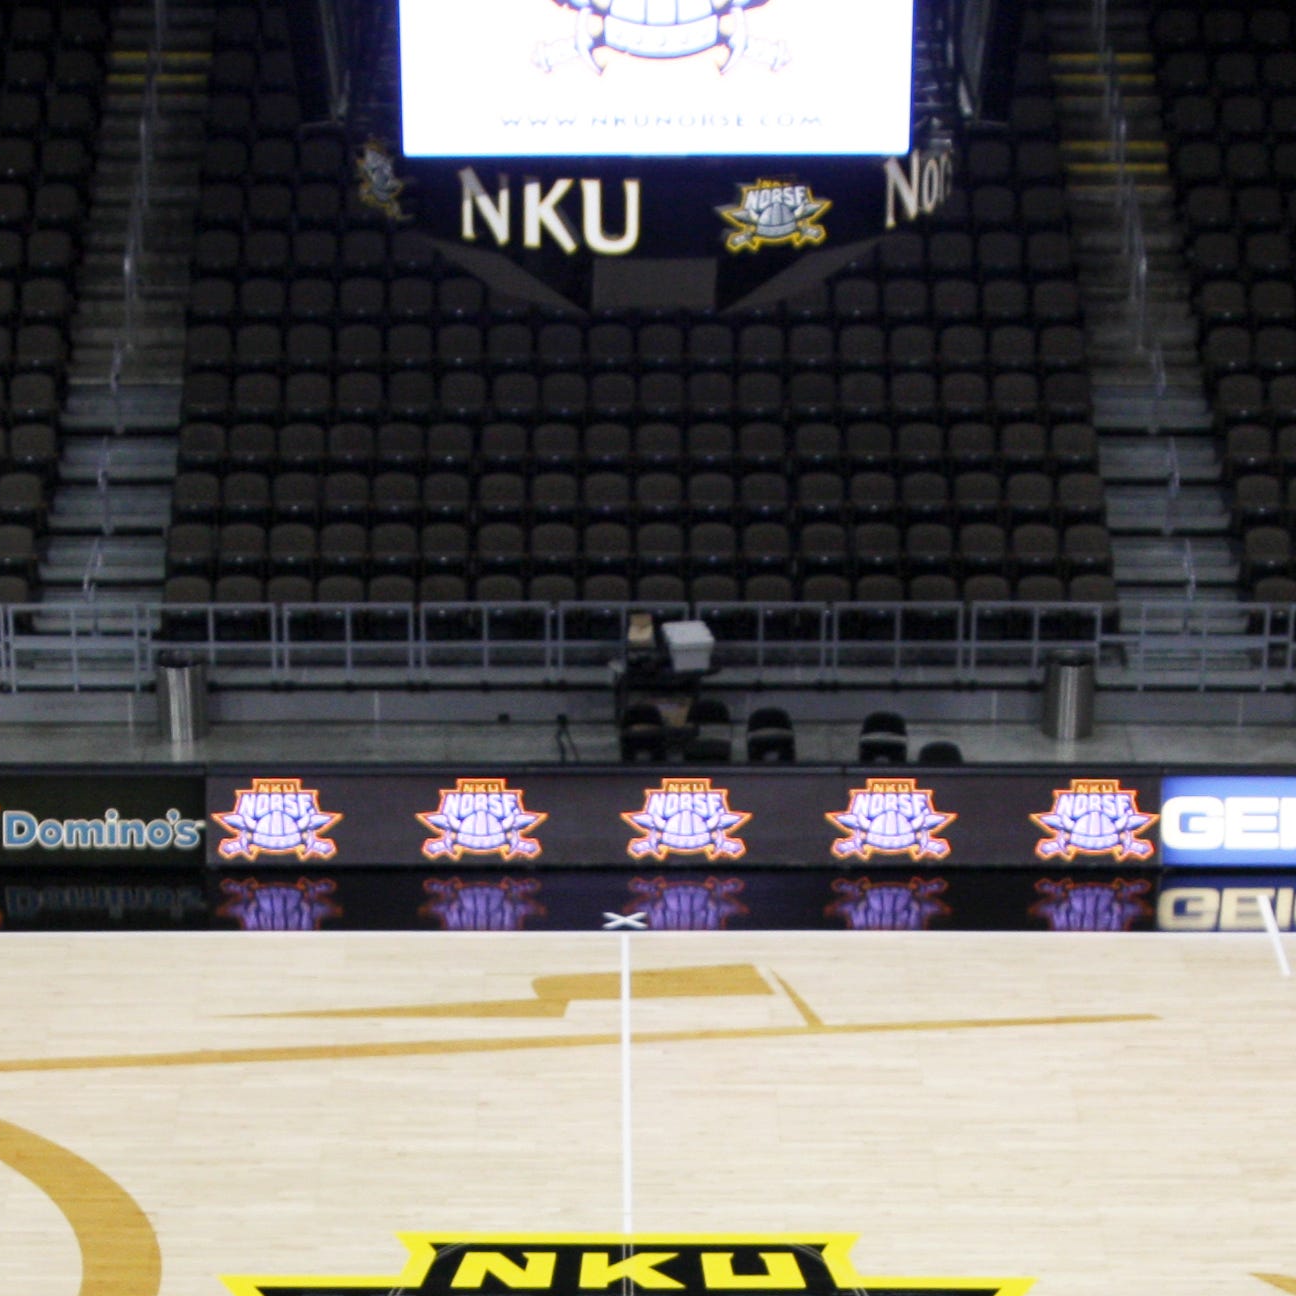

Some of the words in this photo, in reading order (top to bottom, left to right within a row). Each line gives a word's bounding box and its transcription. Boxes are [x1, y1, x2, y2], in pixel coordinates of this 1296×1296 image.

[458, 167, 641, 255] NKU
[258, 782, 296, 793] NKU
[463, 782, 501, 793] NKU
[667, 782, 705, 793] NKU
[872, 782, 911, 793] NKU
[1077, 782, 1115, 793] NKU
[3, 809, 201, 850] Domino's
[448, 1250, 808, 1289] NKU
